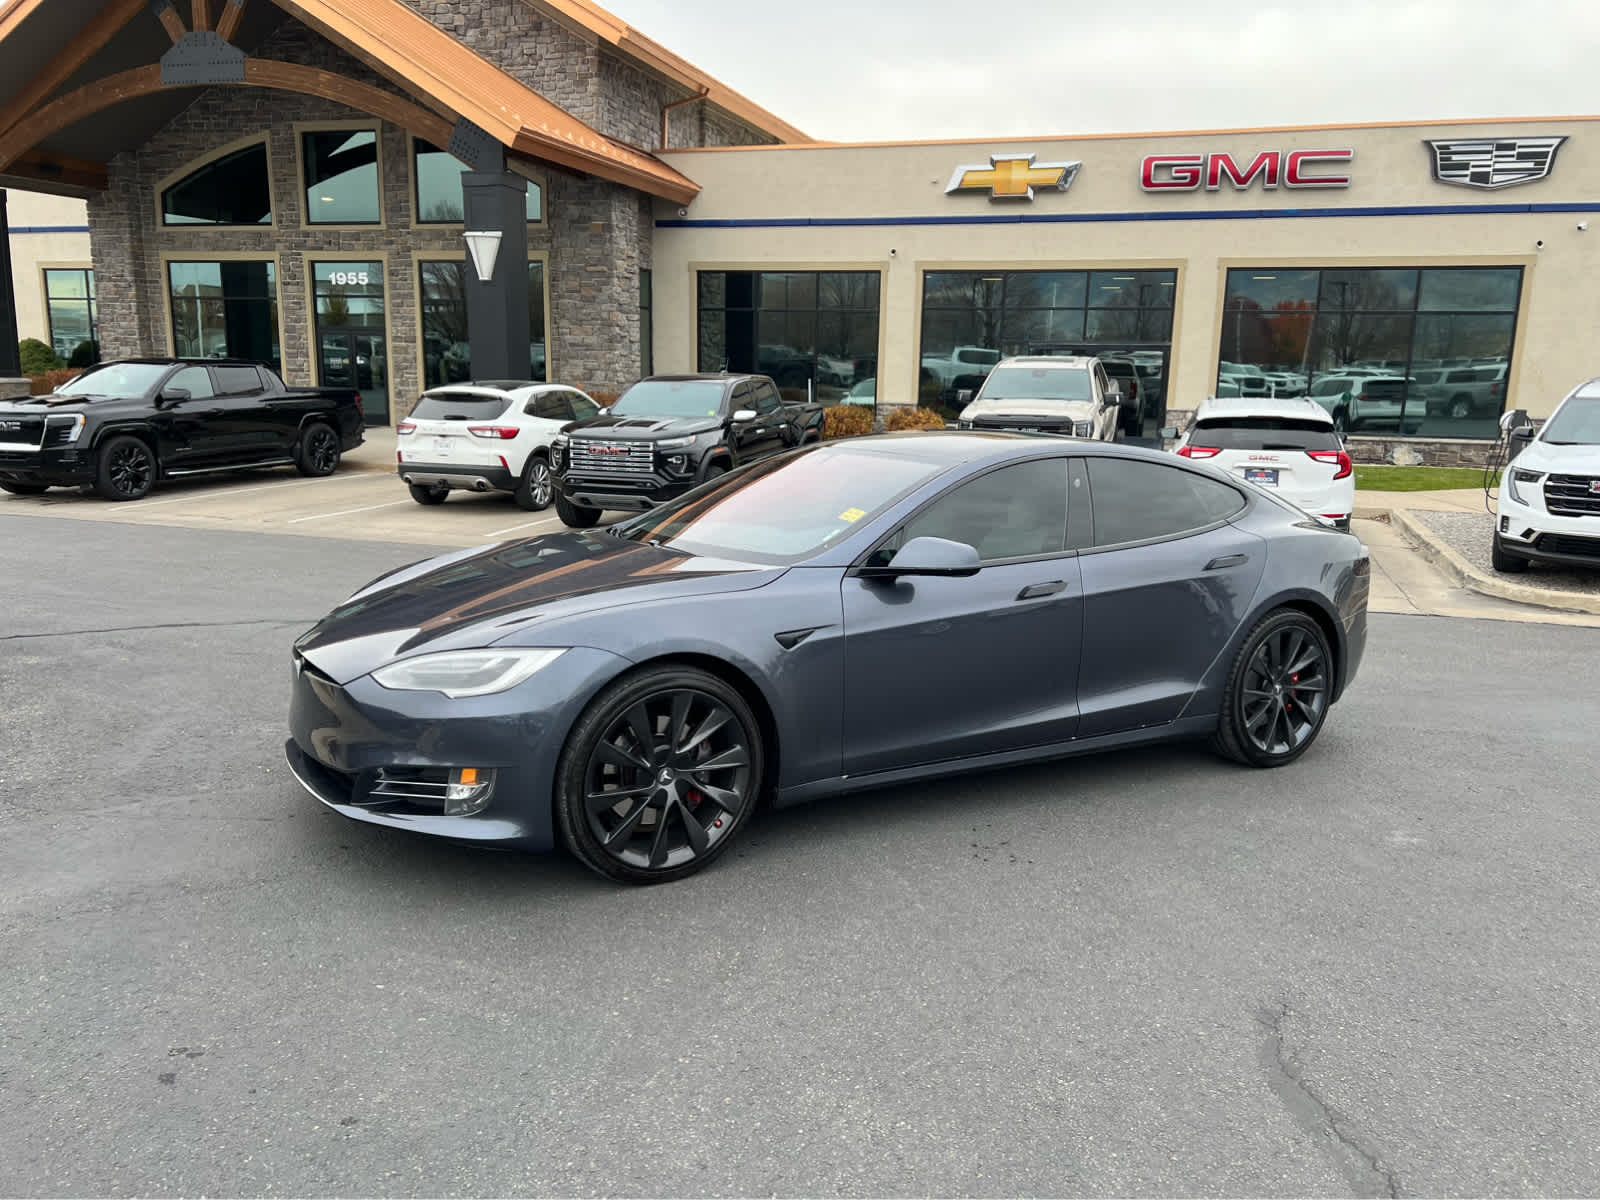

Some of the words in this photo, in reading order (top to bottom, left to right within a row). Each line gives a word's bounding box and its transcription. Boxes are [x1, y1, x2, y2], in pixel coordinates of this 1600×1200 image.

[1140, 149, 1353, 192] GMC
[328, 271, 369, 286] 1955
[588, 445, 631, 457] GMC
